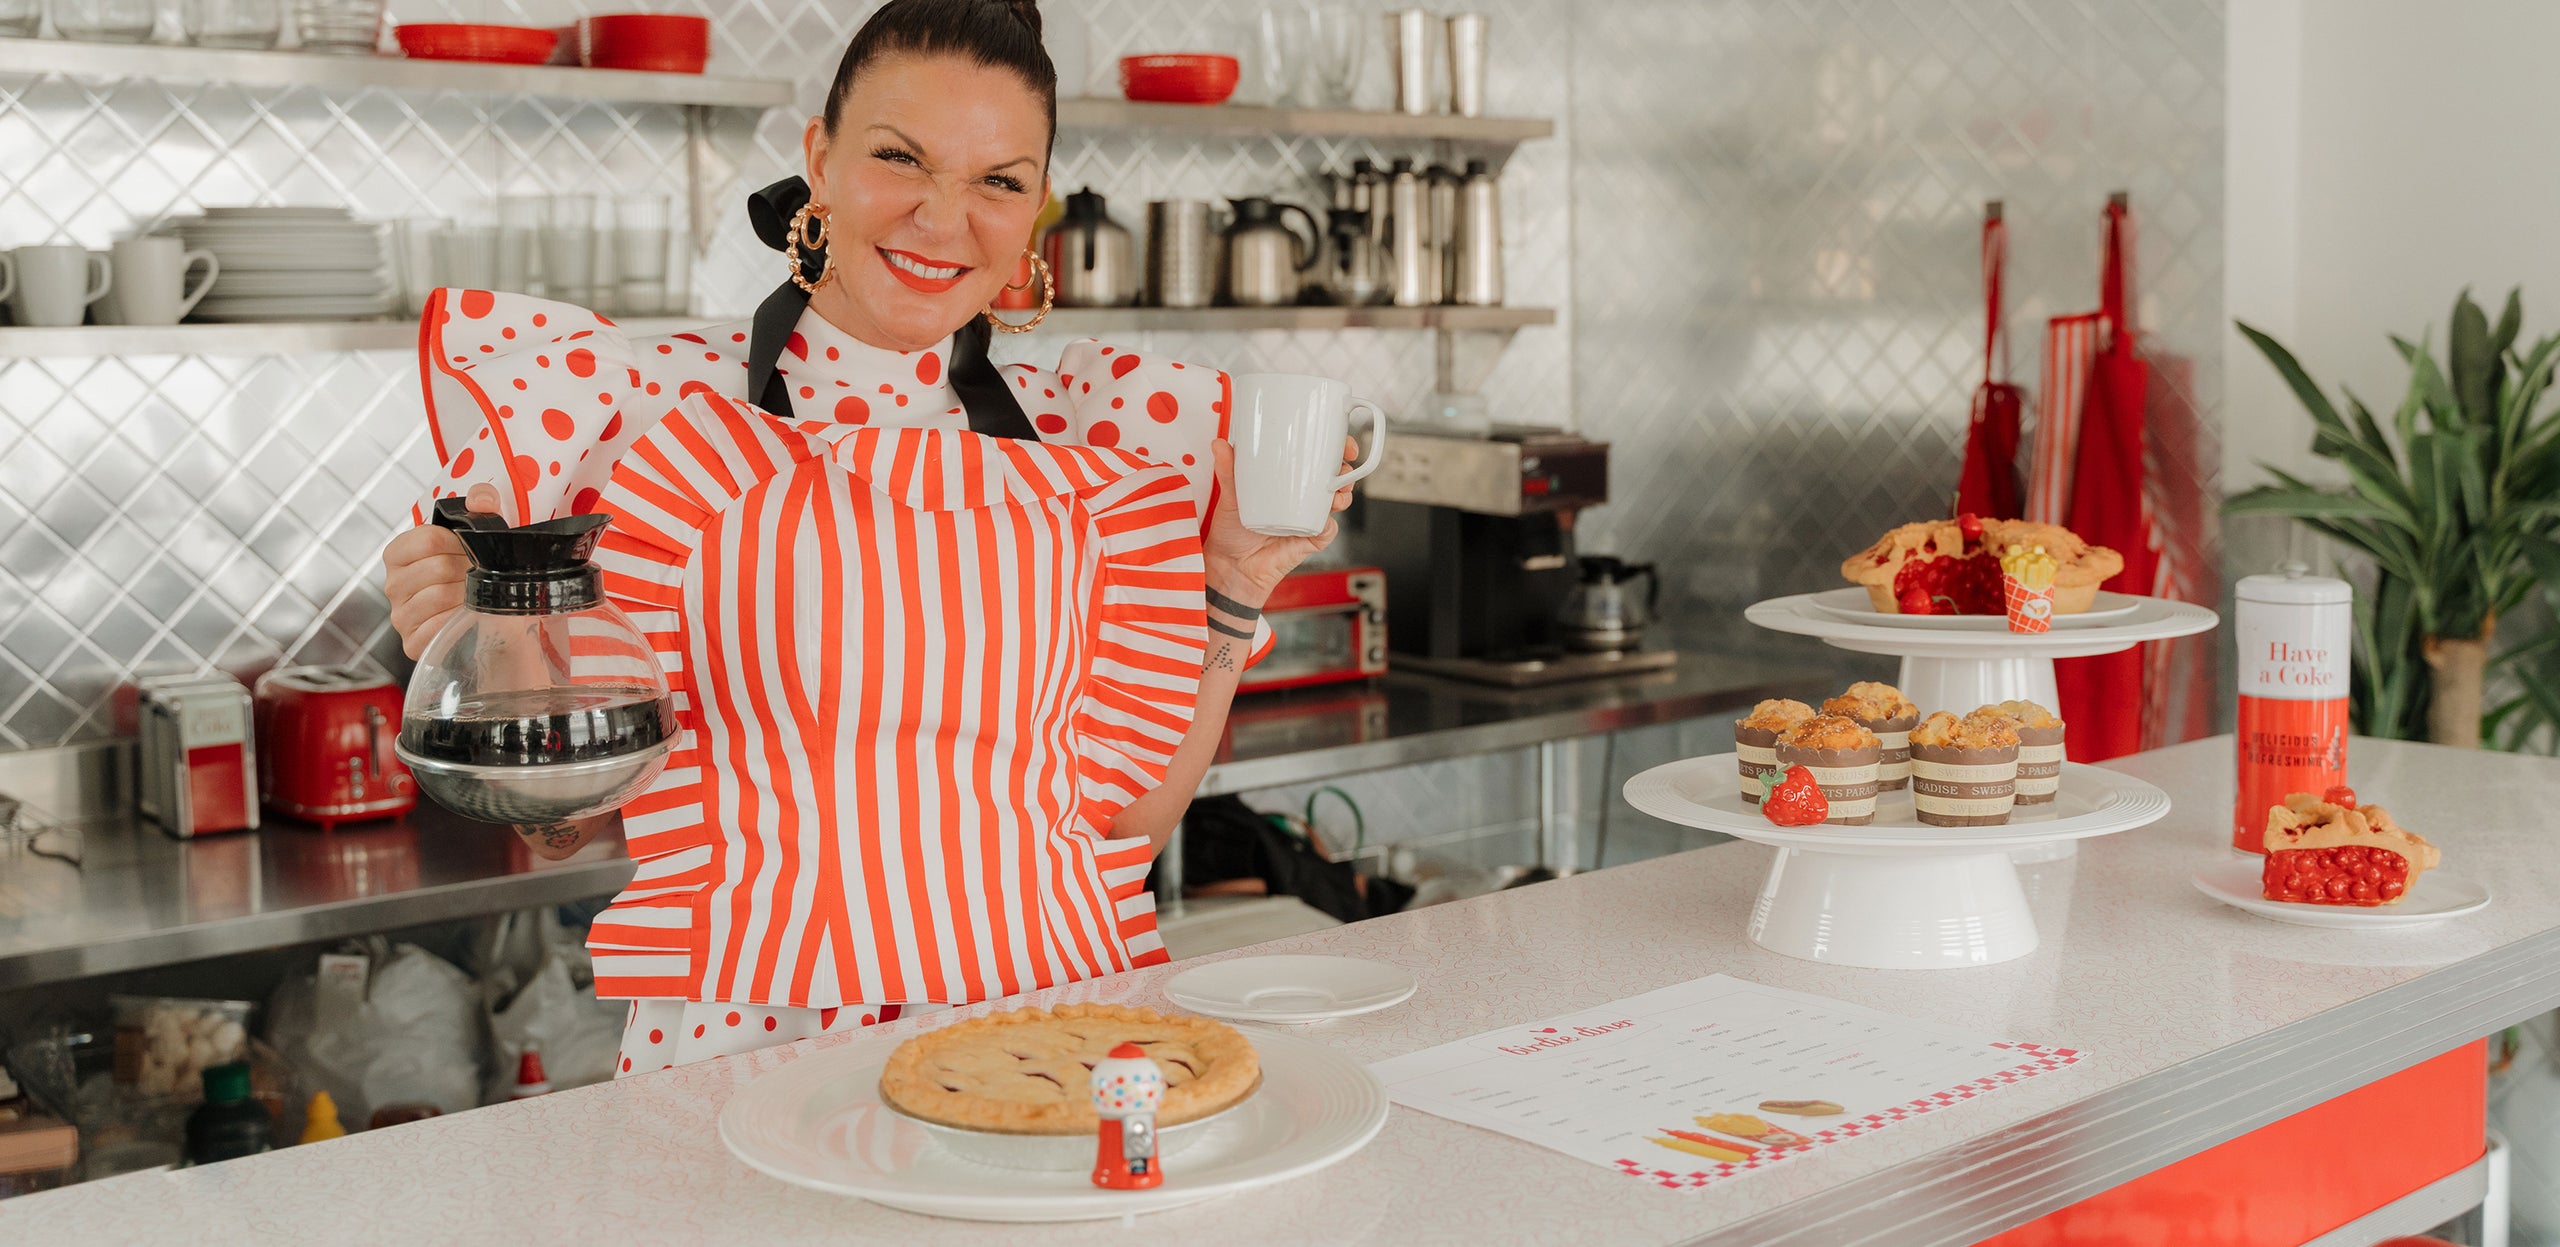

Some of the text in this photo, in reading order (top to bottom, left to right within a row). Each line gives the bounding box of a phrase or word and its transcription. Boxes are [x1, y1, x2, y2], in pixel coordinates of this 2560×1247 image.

[2270, 642, 2328, 662] Have
[2259, 666, 2333, 685] a Coke
[2253, 732, 2318, 747] DELICIOUS
[2248, 752, 2323, 767] REFRESHING
[1916, 781, 1958, 795] ARADISE
[1971, 784, 2012, 796] SWEETS
[1497, 1019, 1635, 1055] birdie diner
